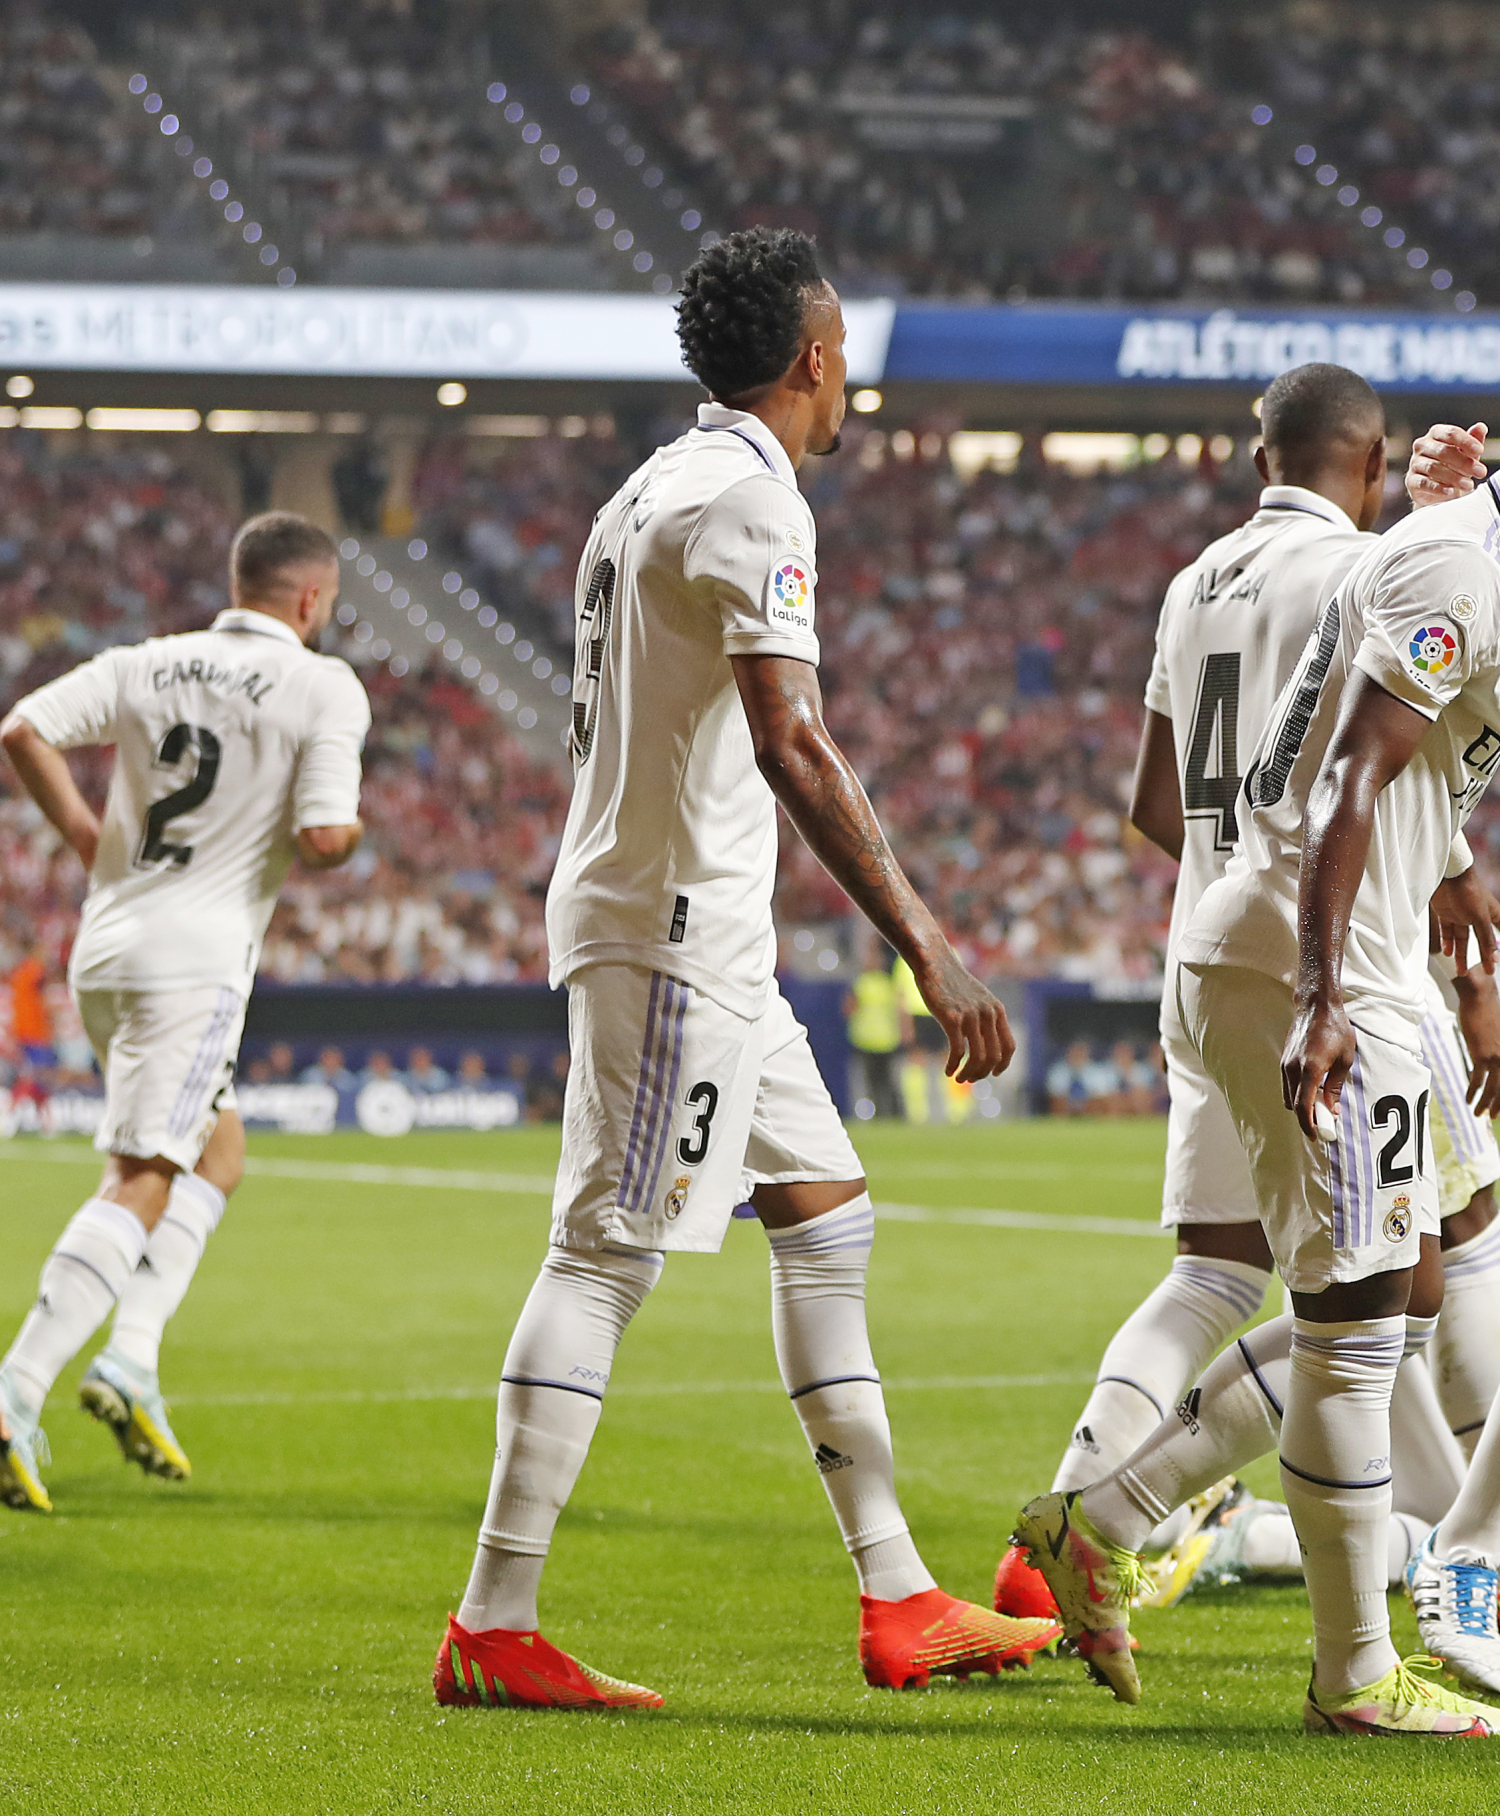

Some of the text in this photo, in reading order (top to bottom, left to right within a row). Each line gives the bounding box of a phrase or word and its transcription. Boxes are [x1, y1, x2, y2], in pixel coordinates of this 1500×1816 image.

[78, 301, 529, 362] METROPOLITANO
[1116, 310, 1331, 380] ATLÉTICO
[1334, 323, 1398, 383] DE
[772, 606, 808, 628] LaLiga
[1183, 651, 1244, 852] 4
[133, 722, 221, 871] 2
[675, 1080, 719, 1167] 3
